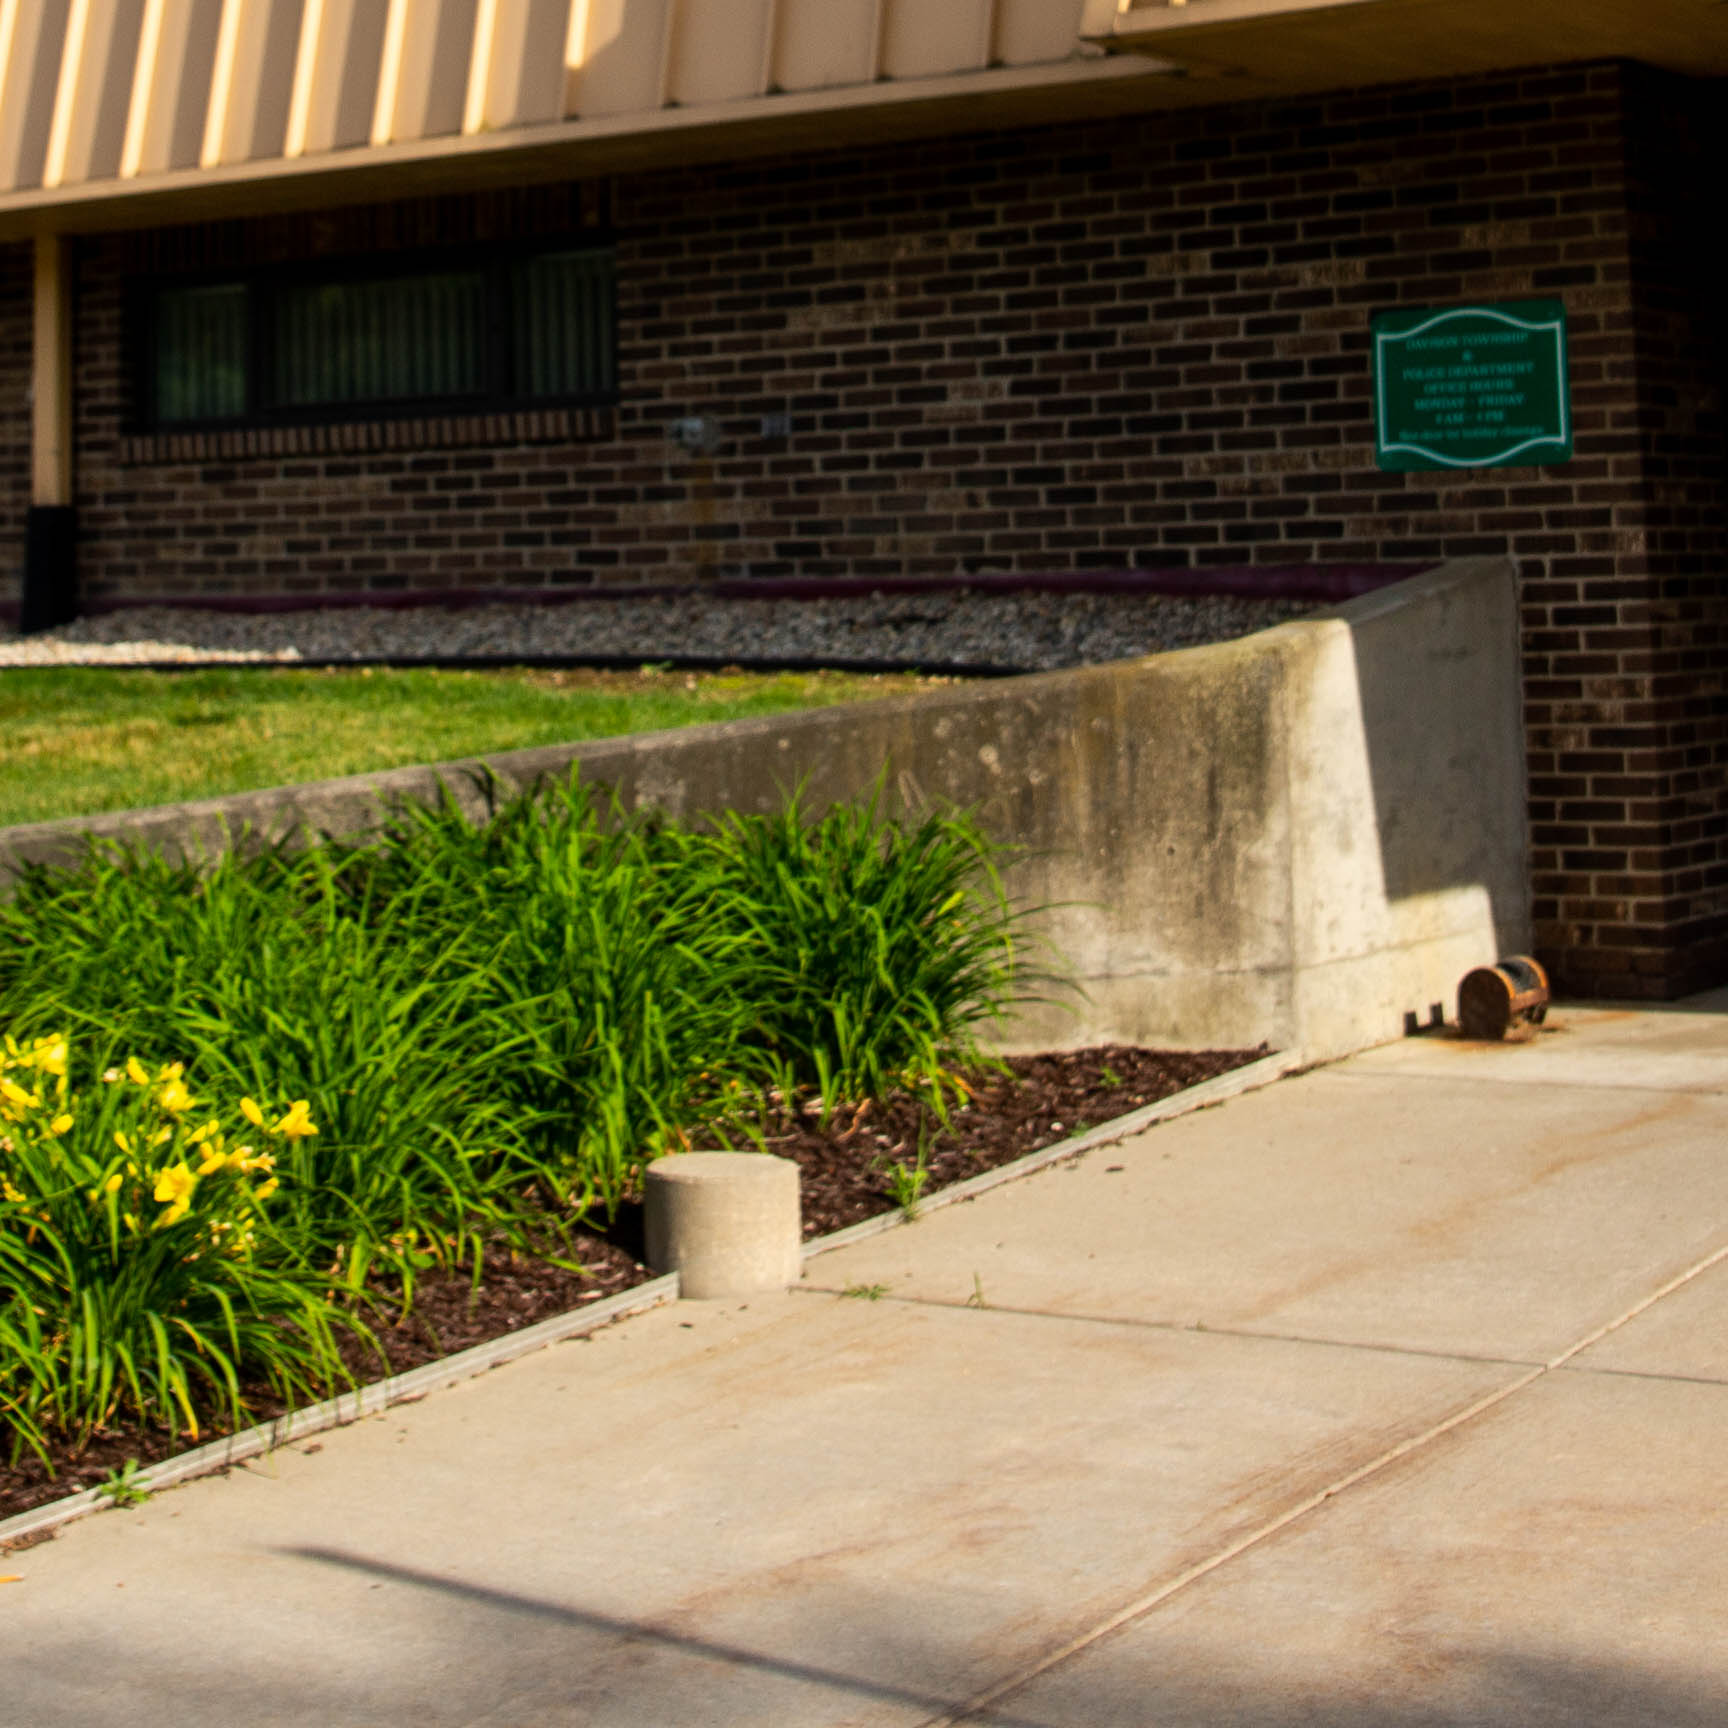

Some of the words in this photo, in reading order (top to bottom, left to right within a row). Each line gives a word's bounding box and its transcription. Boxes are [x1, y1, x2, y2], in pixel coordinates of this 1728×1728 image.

[1463, 332, 1528, 346] TOWNSHIP
[1403, 367, 1445, 379] POLICE
[1448, 362, 1533, 376] DEPARTMENT
[1423, 381, 1467, 394] OFFICE
[1469, 378, 1514, 392] HOURS
[1414, 397, 1465, 410] MONDAY
[1478, 394, 1524, 407] FRIDAY
